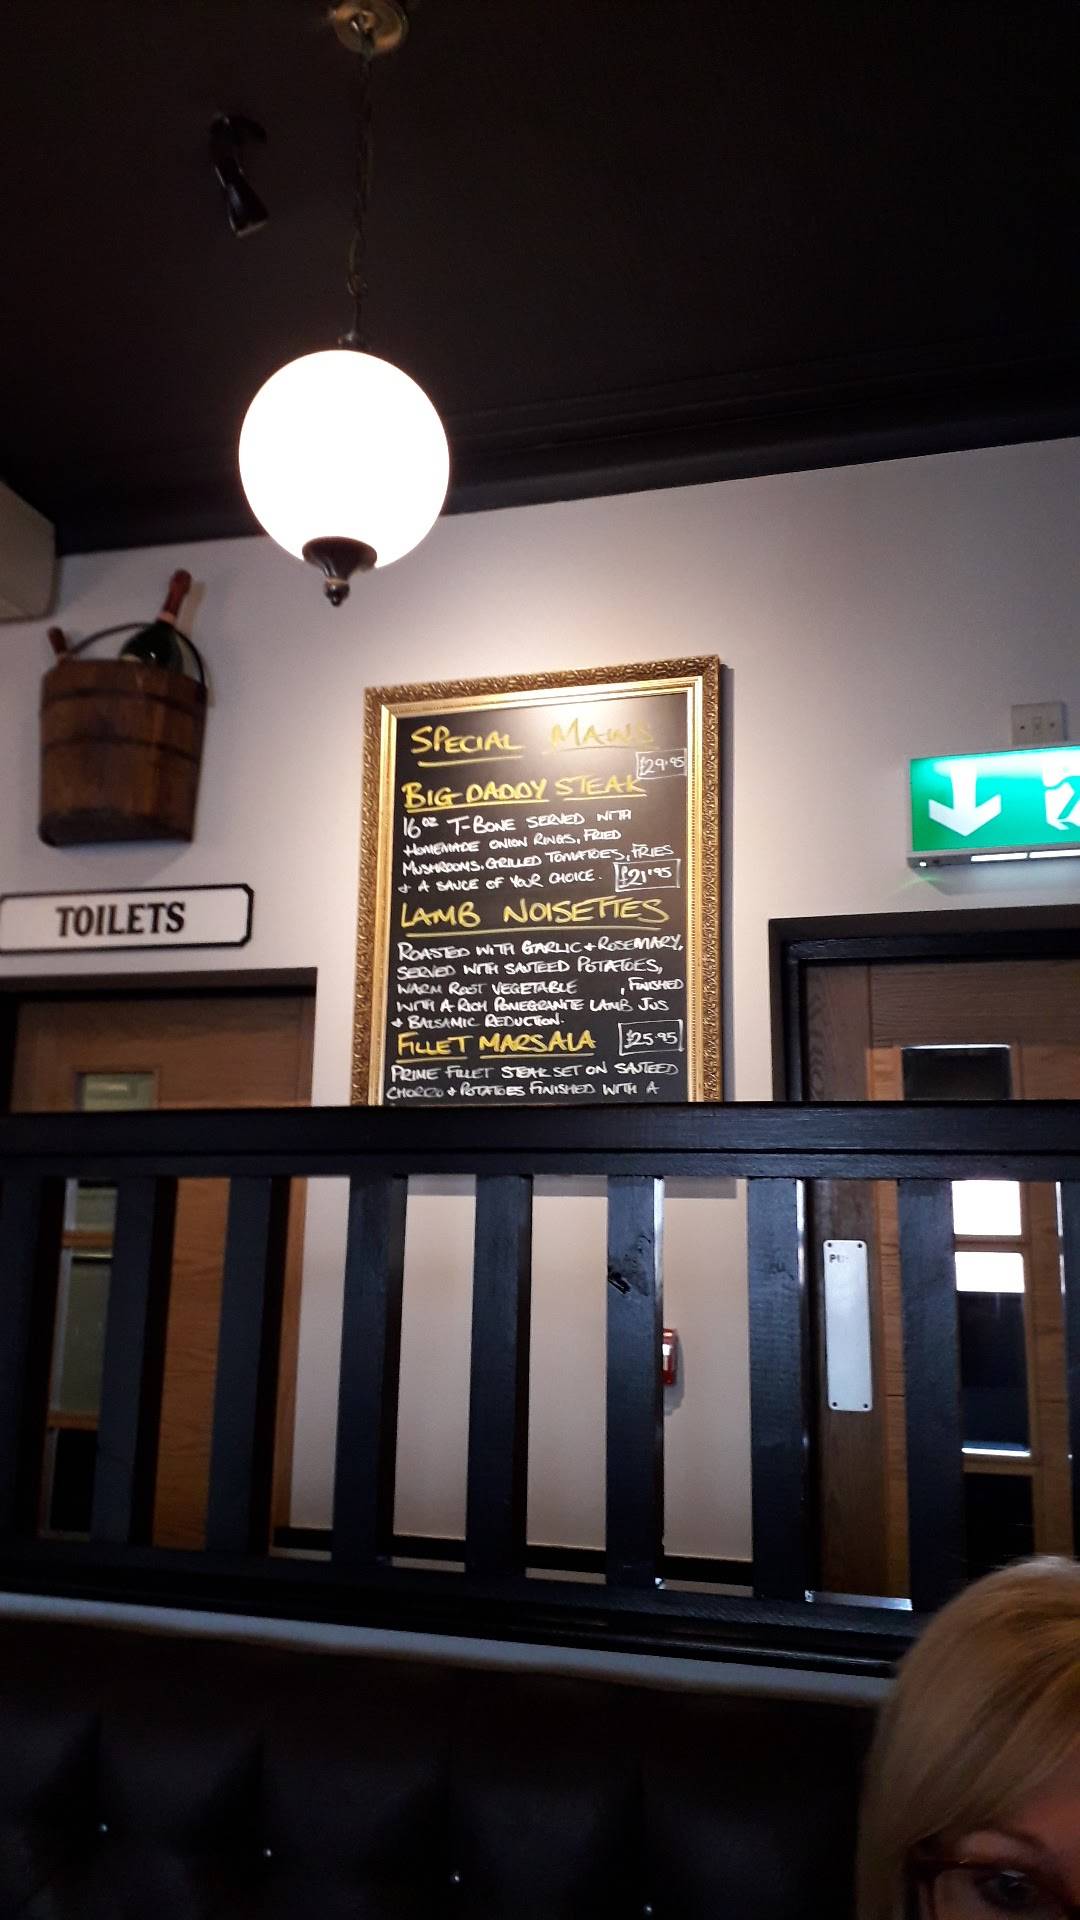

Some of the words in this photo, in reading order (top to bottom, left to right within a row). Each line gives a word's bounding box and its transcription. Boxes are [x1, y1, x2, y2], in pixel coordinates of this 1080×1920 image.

[410, 726, 524, 753] SPECIAL
[550, 717, 656, 749] MAINS
[402, 781, 462, 808] BIG
[466, 779, 547, 802] DADDY
[555, 775, 645, 796] STEAK
[447, 815, 516, 836] T-BONE
[526, 815, 585, 829] SERVED
[596, 809, 632, 822] WITH
[403, 841, 481, 857] HOMEMADE
[489, 836, 528, 850] ONION
[583, 828, 622, 841] FRIED
[485, 855, 543, 870] GRILLED
[632, 844, 674, 859] FRIES
[417, 880, 431, 893] A
[436, 878, 480, 892] SAUCE
[485, 876, 505, 890] OF
[509, 874, 544, 889] YOUR
[55, 901, 186, 937] TOILETS
[400, 901, 482, 929] LAMB
[502, 894, 671, 924] NOISETTES
[397, 941, 471, 962] ROASTED
[475, 942, 516, 957] WITH
[521, 939, 583, 954] GARLIC
[396, 964, 457, 981] SERVED
[462, 962, 500, 976] WITH
[504, 962, 570, 975] SAUTEED
[397, 983, 443, 995] WARM
[491, 979, 579, 995] VEGETABLE
[628, 976, 685, 992] FINISHED
[396, 1000, 436, 1013] WITH
[439, 998, 456, 1013] A
[589, 998, 634, 1012] LAMB
[637, 997, 671, 1012] JUS
[407, 1014, 482, 1030] BALSAMIC
[397, 1031, 475, 1057] FILLET
[478, 1030, 597, 1054] MARSALA
[390, 1064, 442, 1083] PRIME
[444, 1064, 496, 1080] FILLET
[500, 1065, 552, 1079] STEAK
[553, 1064, 583, 1078] SET
[585, 1060, 609, 1075] ON
[613, 1061, 681, 1076] SAUTEED
[528, 1080, 597, 1096] FINISHED
[601, 1083, 638, 1096] WITH
[645, 1080, 661, 1095] A
